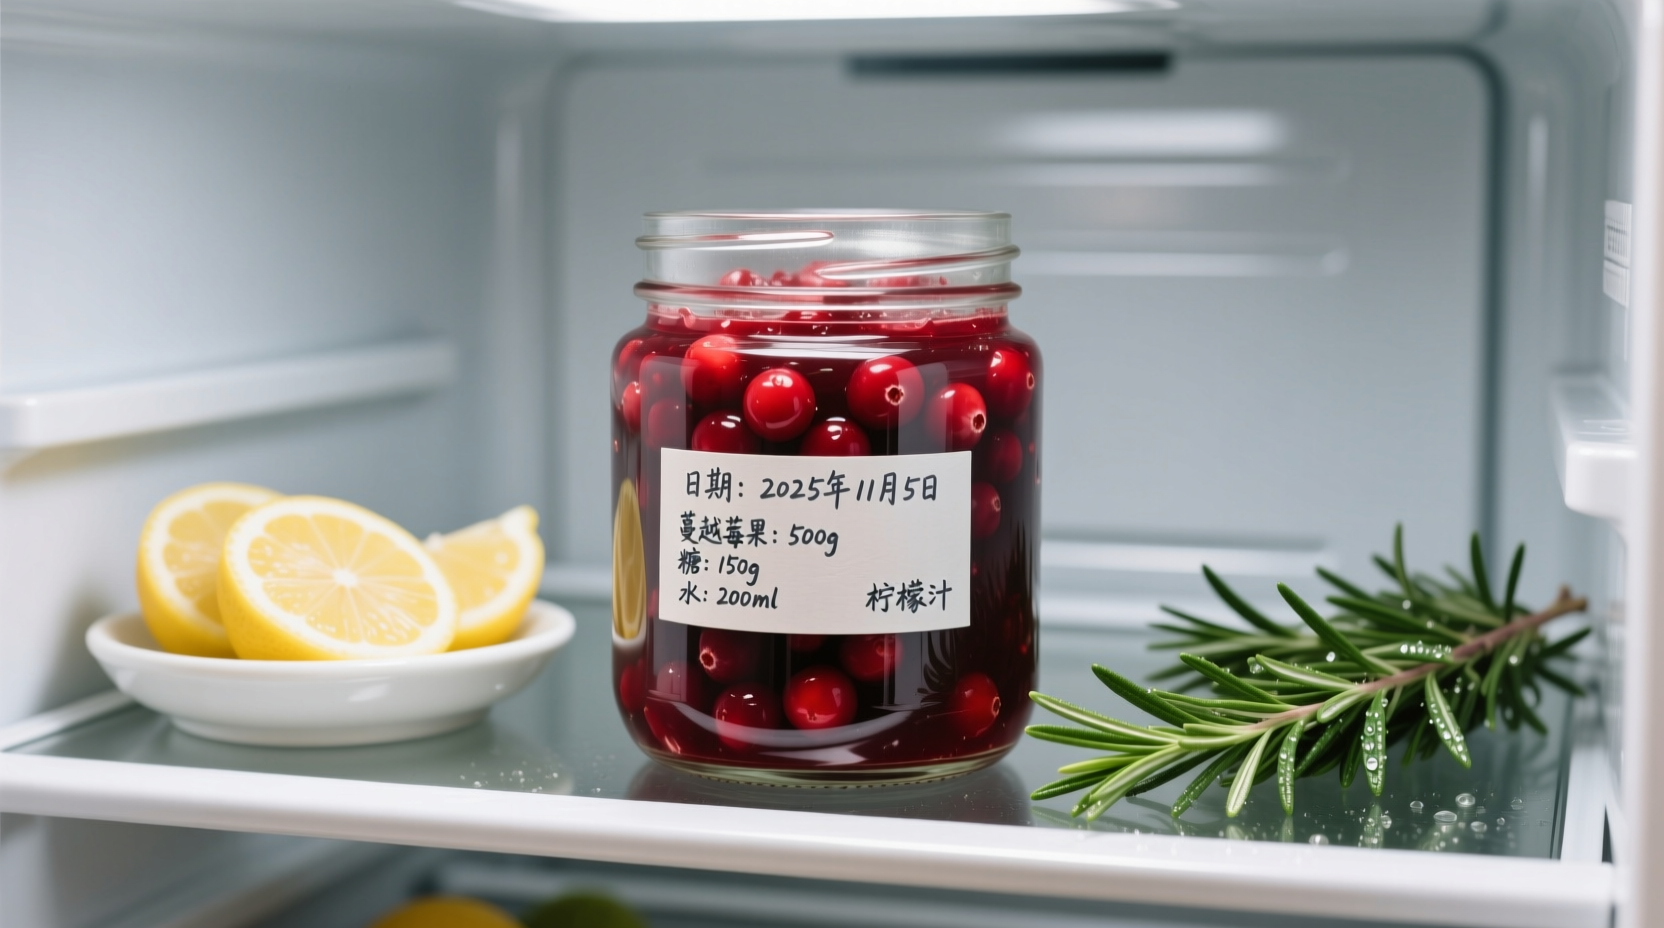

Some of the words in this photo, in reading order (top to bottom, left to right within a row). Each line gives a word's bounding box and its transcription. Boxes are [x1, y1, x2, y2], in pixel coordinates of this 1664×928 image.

[759, 469, 937, 509] 2025年11月5日
[788, 523, 839, 557] 500g
[718, 555, 760, 586] 150g
[716, 586, 779, 609] 200ml
[865, 579, 953, 613] 柠檬汁
